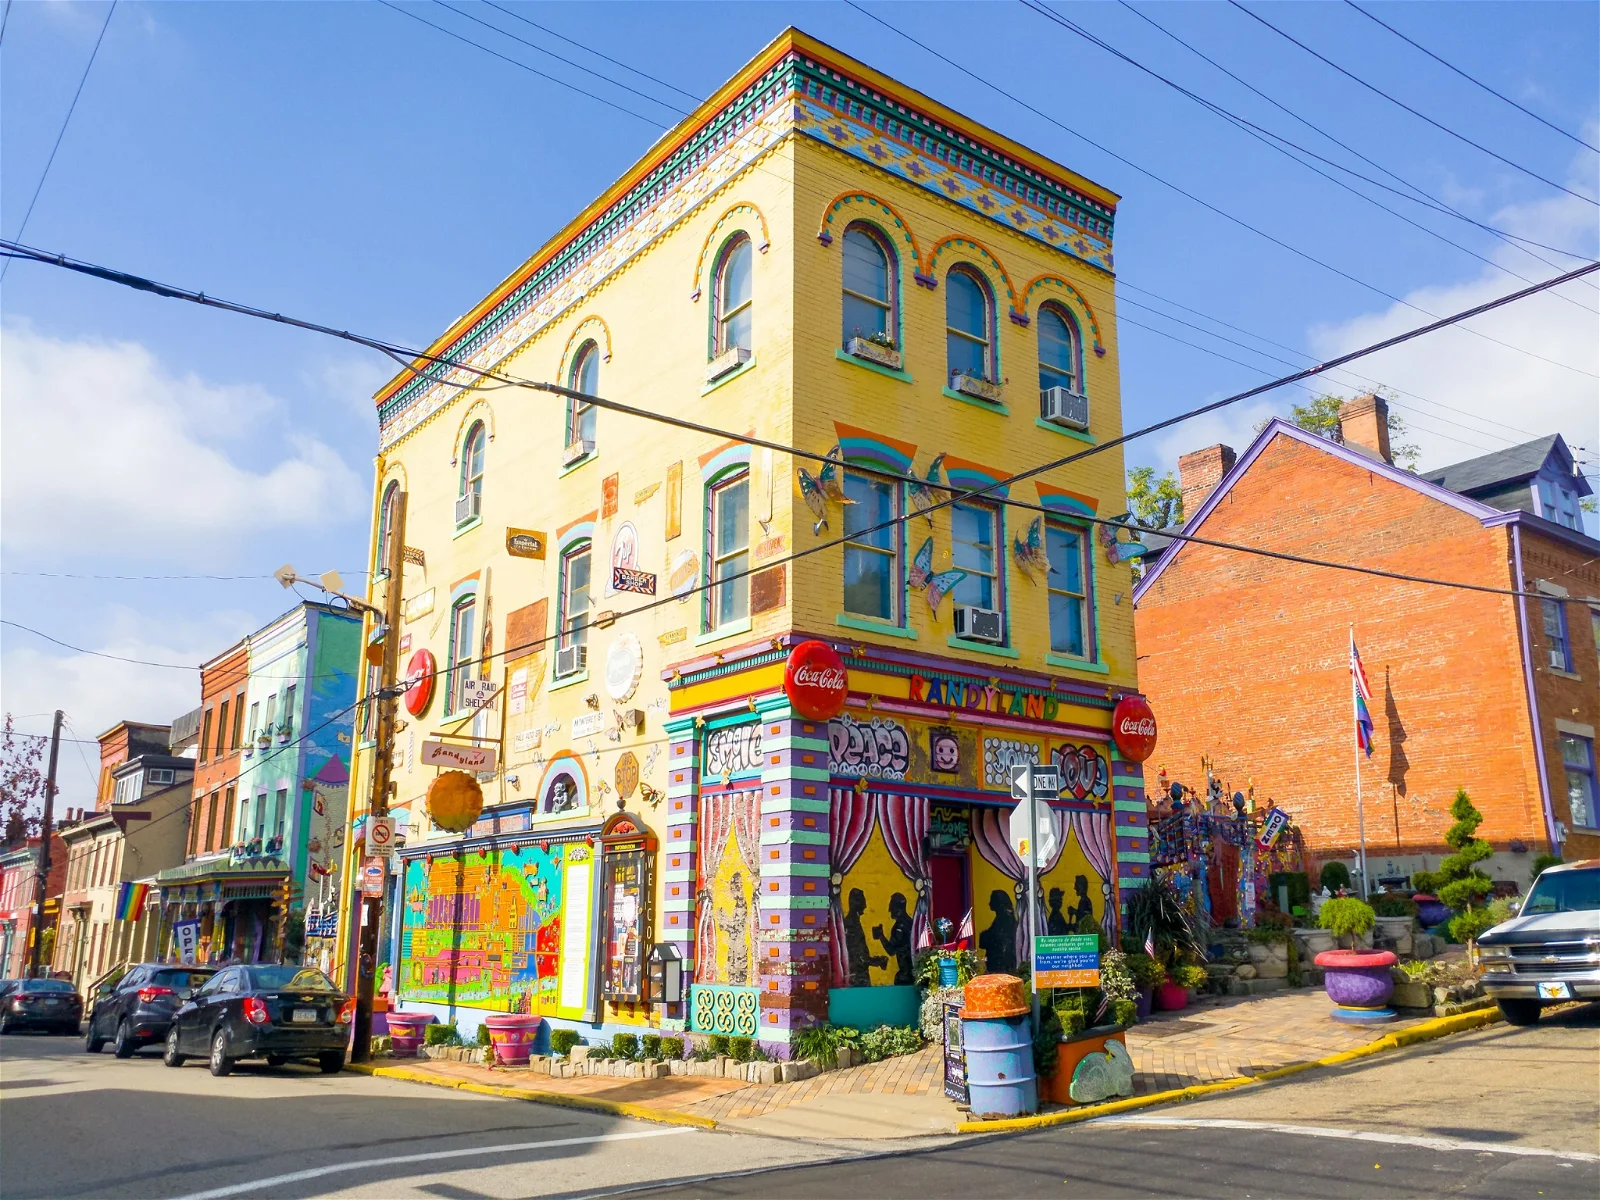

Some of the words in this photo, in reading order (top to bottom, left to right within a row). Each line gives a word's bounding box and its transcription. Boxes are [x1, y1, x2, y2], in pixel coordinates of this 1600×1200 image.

[621, 574, 647, 583] BARBER
[625, 580, 643, 588] SHOP
[464, 680, 476, 691] AIR
[481, 682, 497, 692] RAID
[793, 665, 844, 690] Coca-Cola
[909, 674, 1059, 720] RANDYLAND
[1120, 716, 1156, 736] Coca-Cola
[431, 746, 486, 765] Randyland
[1261, 815, 1282, 845] OPEN
[645, 855, 655, 975] WELCOM
